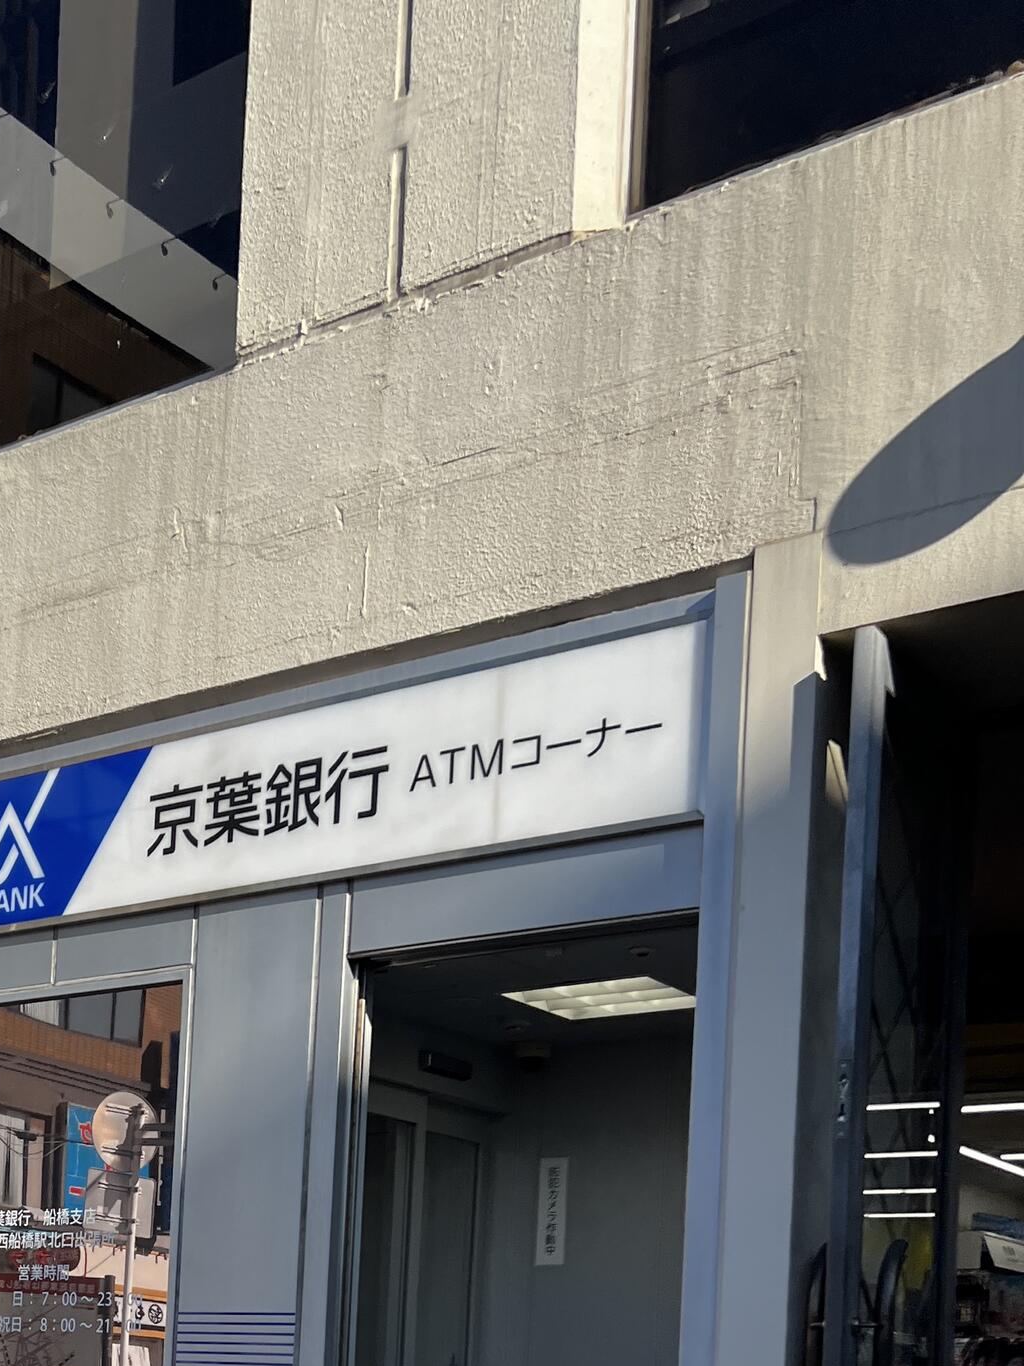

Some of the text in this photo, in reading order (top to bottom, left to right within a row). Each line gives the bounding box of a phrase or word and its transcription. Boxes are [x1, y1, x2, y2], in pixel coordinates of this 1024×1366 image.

[147, 717, 663, 857] 京葉銀行 ATMコーナー
[42, 1208, 97, 1227] 船橋支店
[18, 1264, 70, 1282] 営業時間
